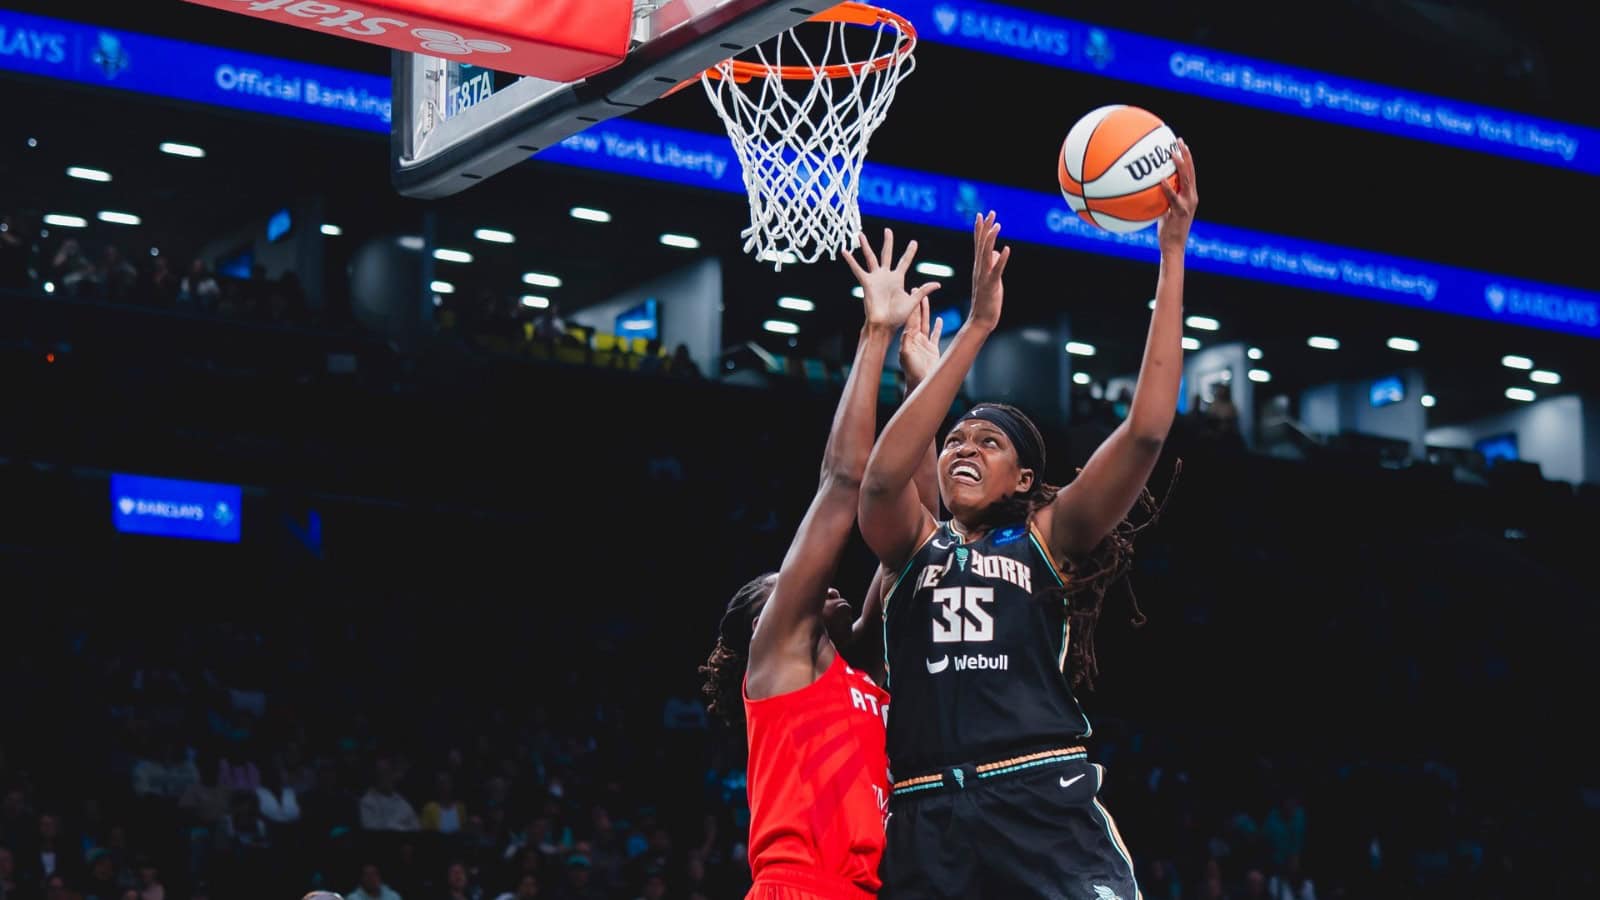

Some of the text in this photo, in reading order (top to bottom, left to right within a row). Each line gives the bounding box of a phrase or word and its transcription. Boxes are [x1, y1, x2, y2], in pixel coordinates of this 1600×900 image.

[236, 0, 407, 36] Stat
[960, 14, 1067, 54] BARCLAYS
[215, 64, 391, 122] Official Banking
[1169, 52, 1578, 160] Official Banking Partner of the New York Liberty
[561, 132, 727, 179] ew York Liberty
[1249, 245, 1269, 268] of
[1270, 248, 1299, 274] the
[1300, 252, 1339, 280] New
[1340, 259, 1375, 286] York
[1377, 266, 1438, 301] Liberty
[1508, 288, 1598, 327] BARCLAYS
[135, 499, 204, 521] BARCLAYS
[971, 549, 1032, 594] YORK
[932, 587, 994, 642] 35
[954, 654, 1008, 670] Webull
